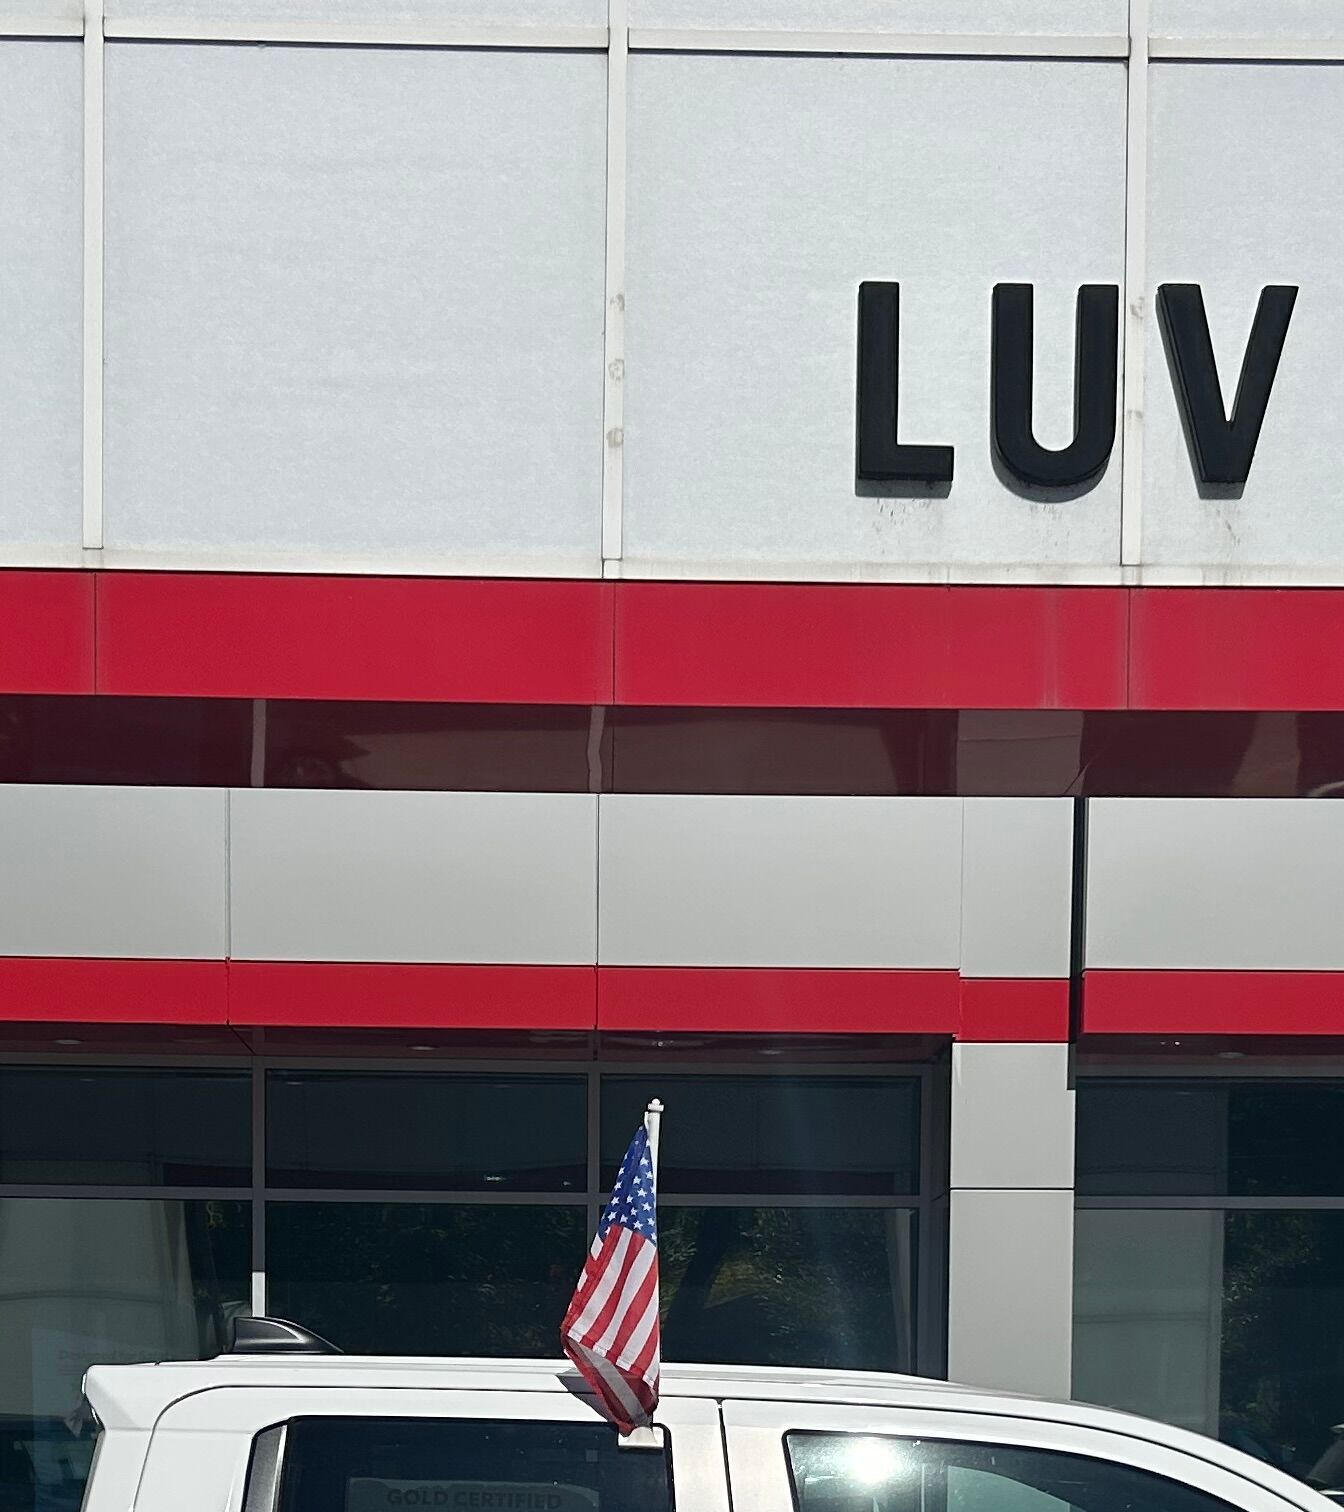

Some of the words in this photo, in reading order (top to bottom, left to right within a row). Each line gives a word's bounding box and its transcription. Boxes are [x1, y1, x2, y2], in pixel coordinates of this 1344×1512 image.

[855, 281, 1299, 503] LUV
[387, 1488, 449, 1505] GOLD
[453, 1490, 562, 1509] CERTIFIED
